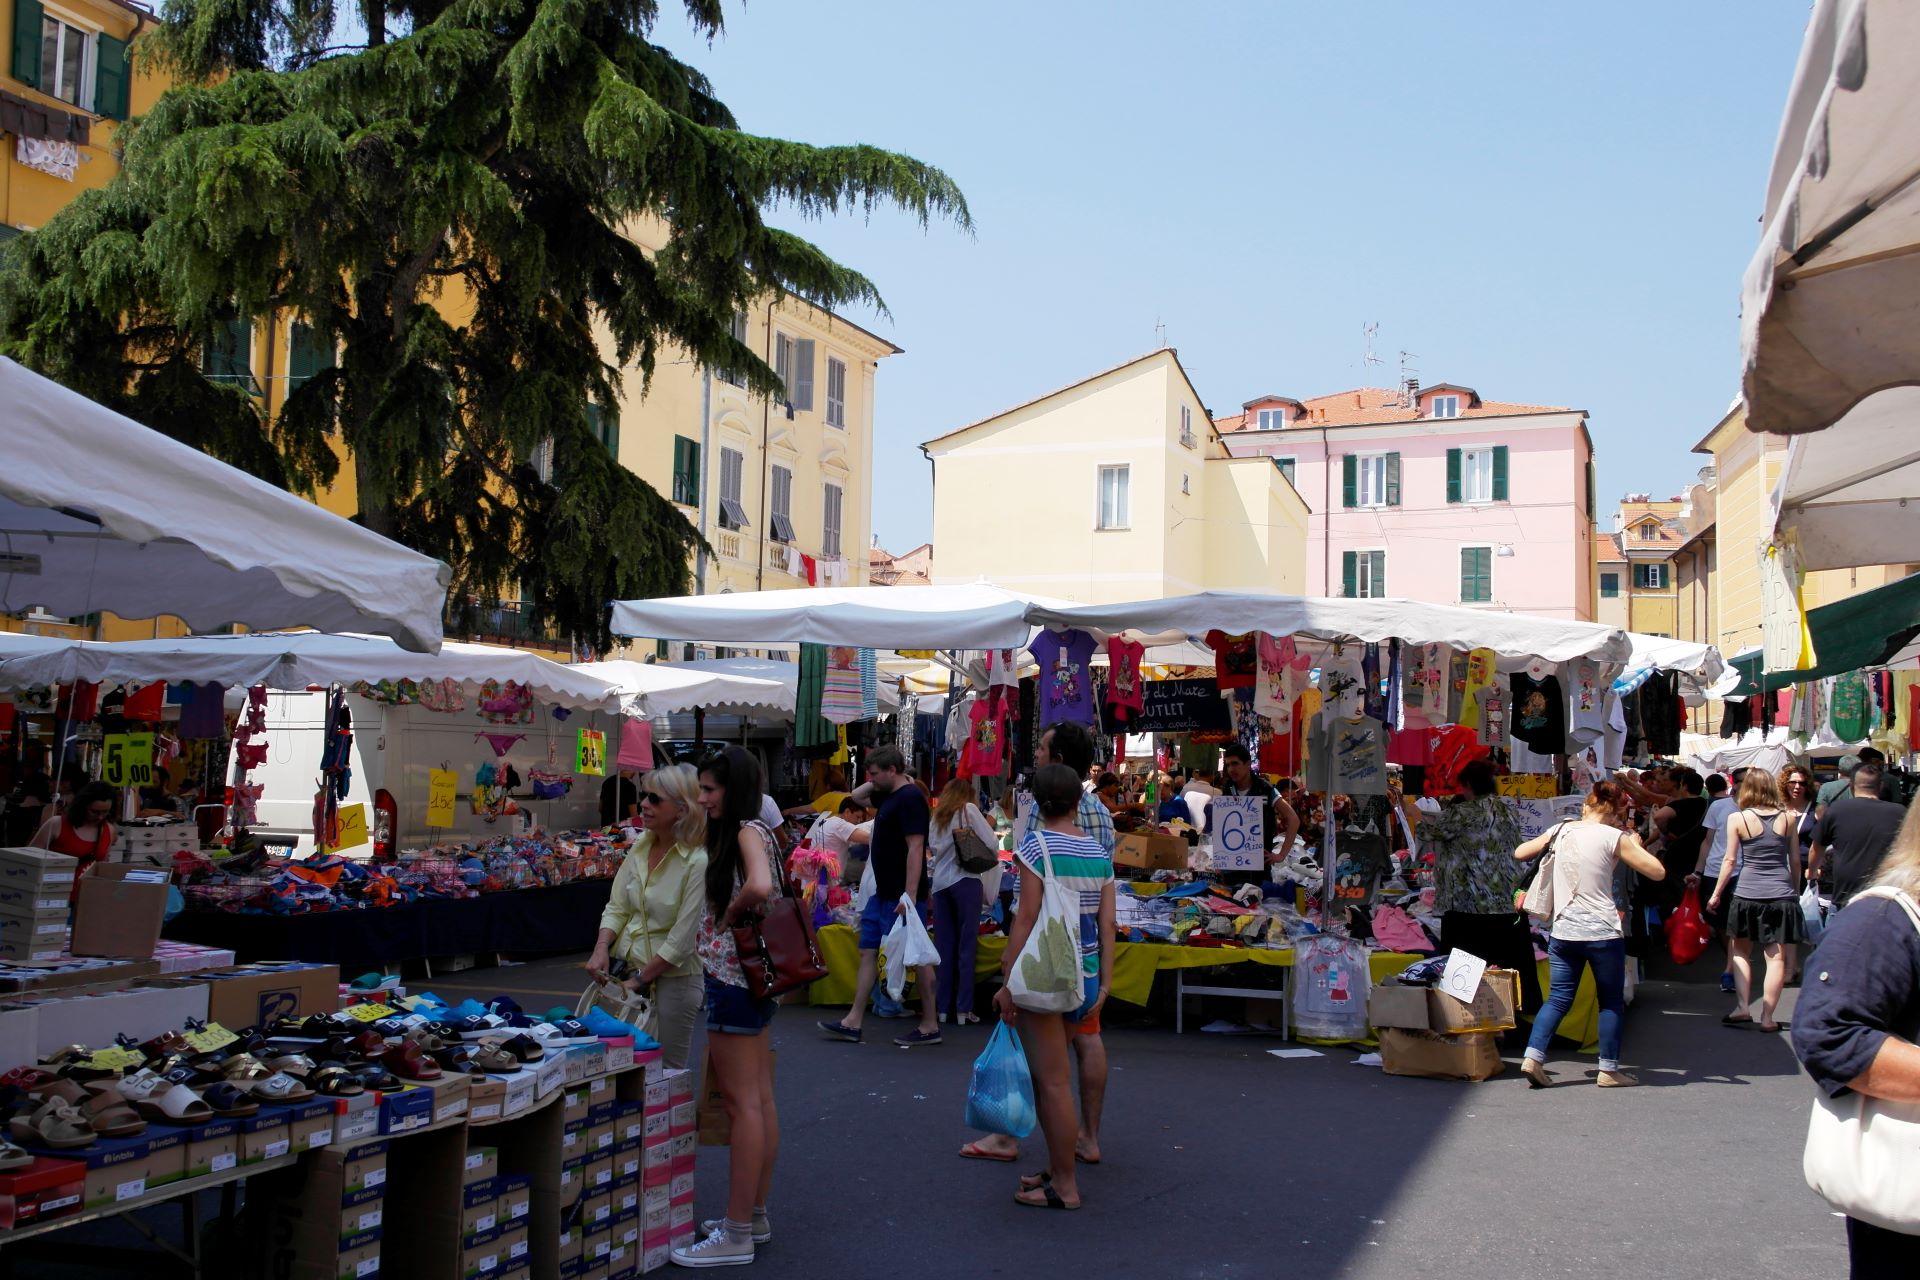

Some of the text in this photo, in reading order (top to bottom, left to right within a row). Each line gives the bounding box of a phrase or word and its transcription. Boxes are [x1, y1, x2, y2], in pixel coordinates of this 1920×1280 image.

[1171, 682, 1211, 698] Mare
[1501, 776, 1526, 785] EURO
[1221, 810, 1246, 852] 6
